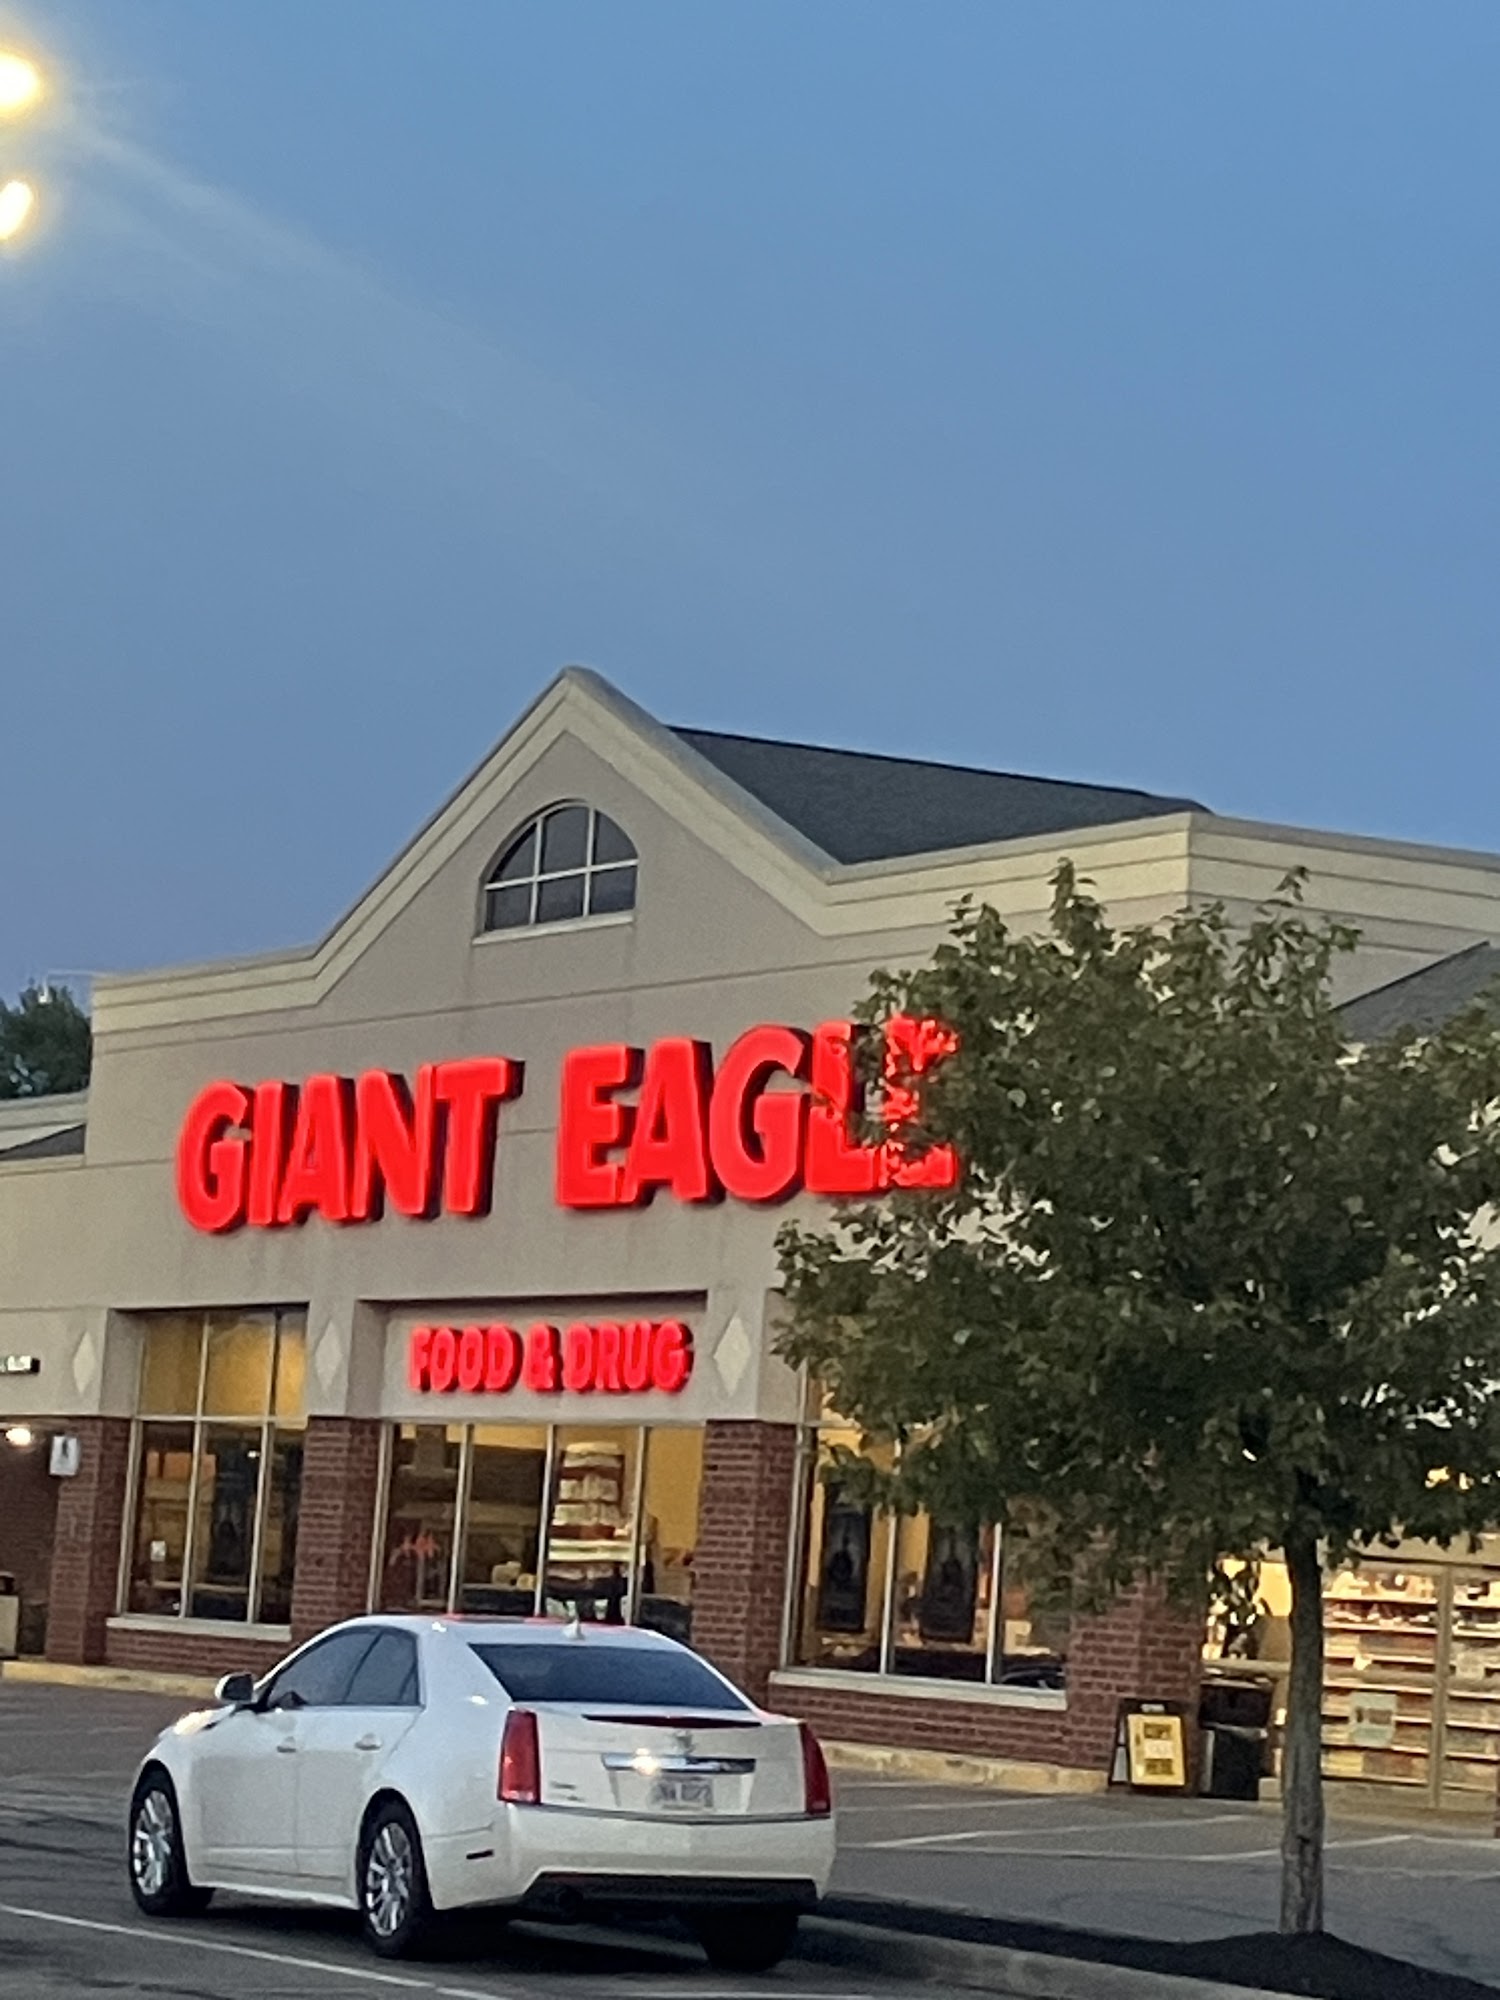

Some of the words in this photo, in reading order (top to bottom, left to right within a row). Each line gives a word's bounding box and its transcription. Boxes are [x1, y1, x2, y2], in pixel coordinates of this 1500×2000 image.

[175, 1056, 519, 1234] GIANT
[409, 1322, 521, 1394] FOOD
[523, 1322, 562, 1393] &
[562, 1319, 693, 1394] DRUG
